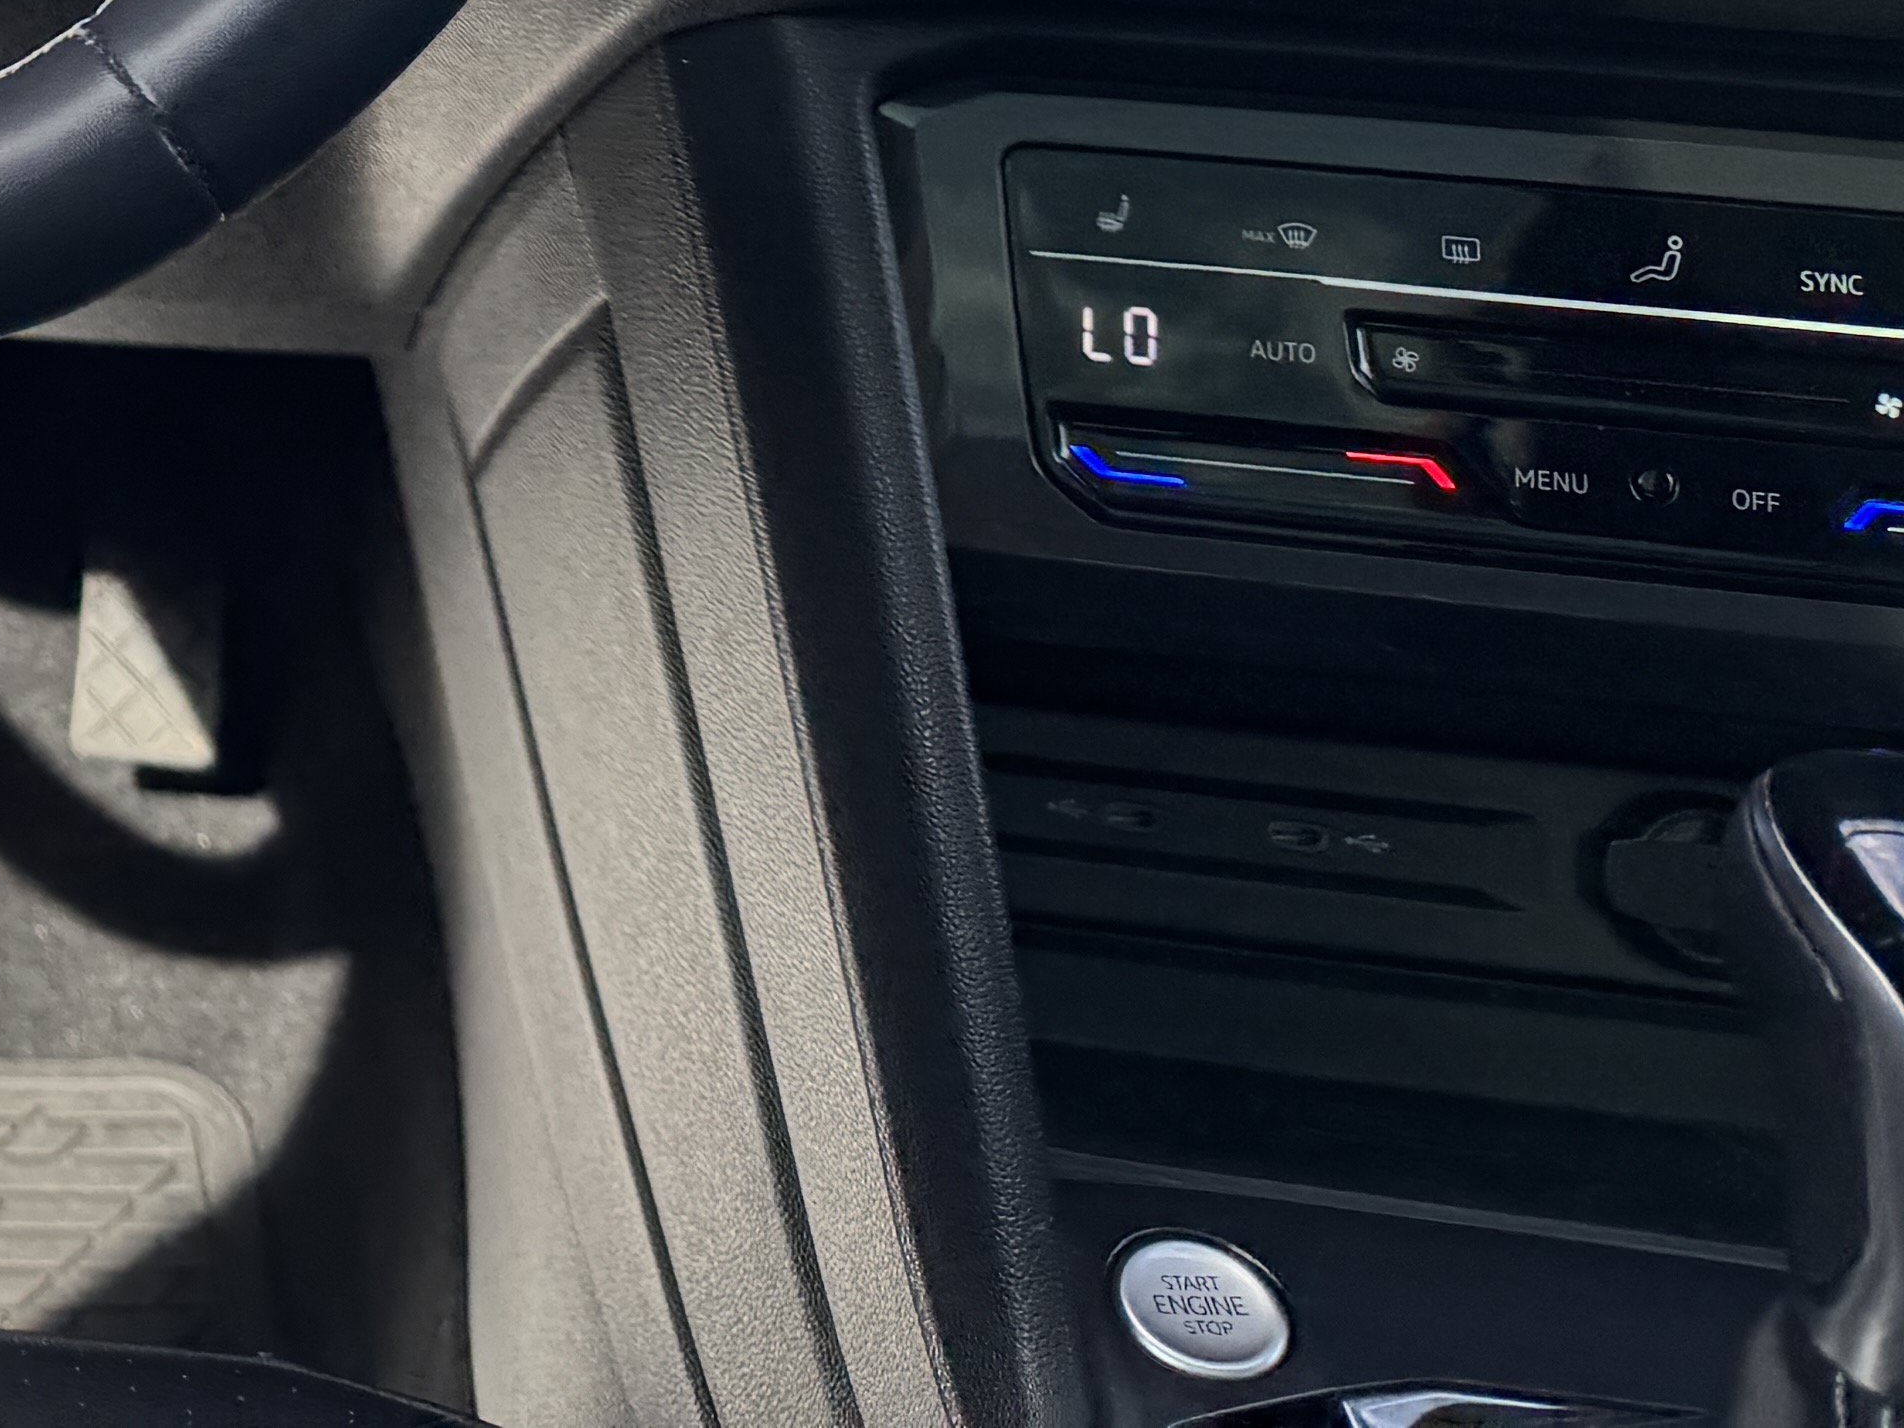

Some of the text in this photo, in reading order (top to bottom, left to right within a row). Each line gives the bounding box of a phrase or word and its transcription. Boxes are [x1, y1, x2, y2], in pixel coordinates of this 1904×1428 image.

[1241, 228, 1276, 244] MAX
[1799, 269, 1866, 297] SYNC
[1081, 305, 1159, 367] LO
[1249, 338, 1317, 365] AUTO
[1513, 466, 1590, 496] MENU
[1731, 487, 1782, 514] OFF
[1159, 1273, 1220, 1293] START
[1152, 1293, 1250, 1318] ENGINE
[1183, 1319, 1234, 1337] STOP
